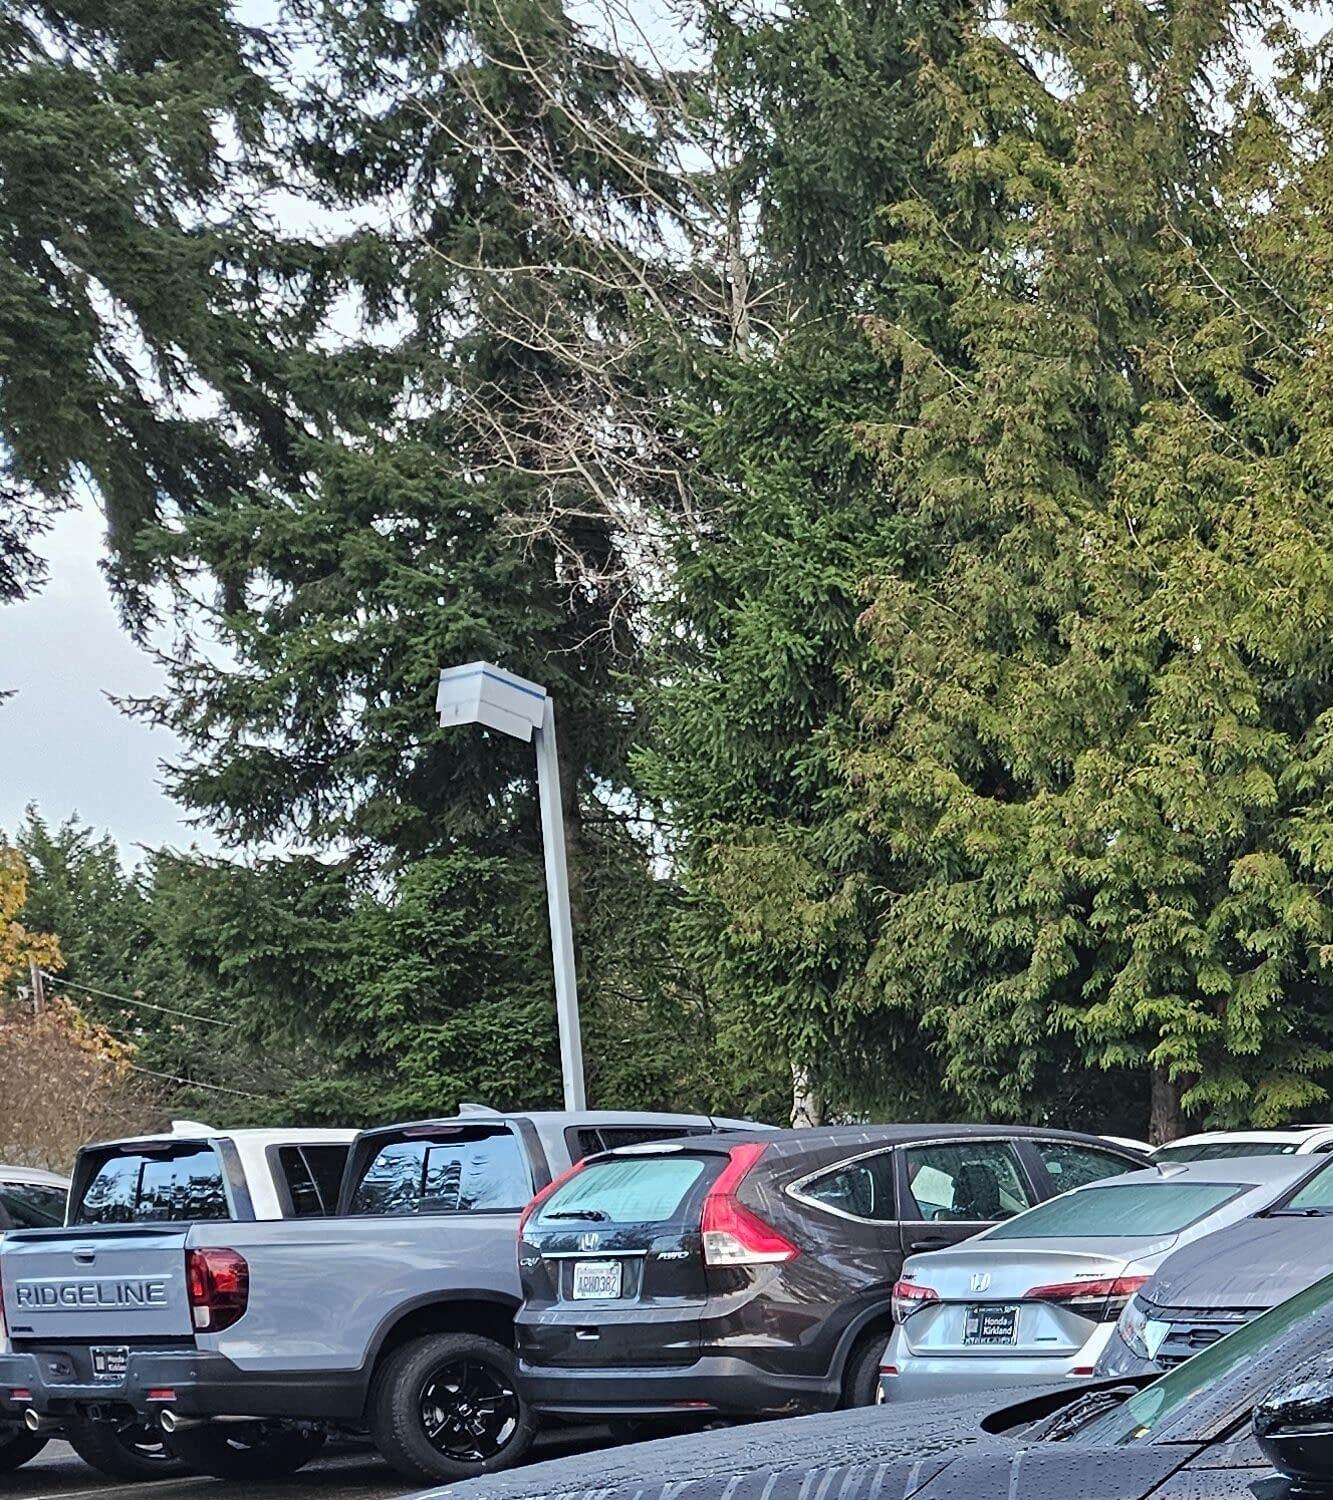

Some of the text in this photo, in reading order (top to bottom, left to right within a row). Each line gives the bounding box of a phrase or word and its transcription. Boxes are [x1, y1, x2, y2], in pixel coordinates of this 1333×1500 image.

[16, 1282, 168, 1308] RIDGELINE
[984, 1316, 1007, 1325] Honda
[983, 1326, 1013, 1335] Kirkland
